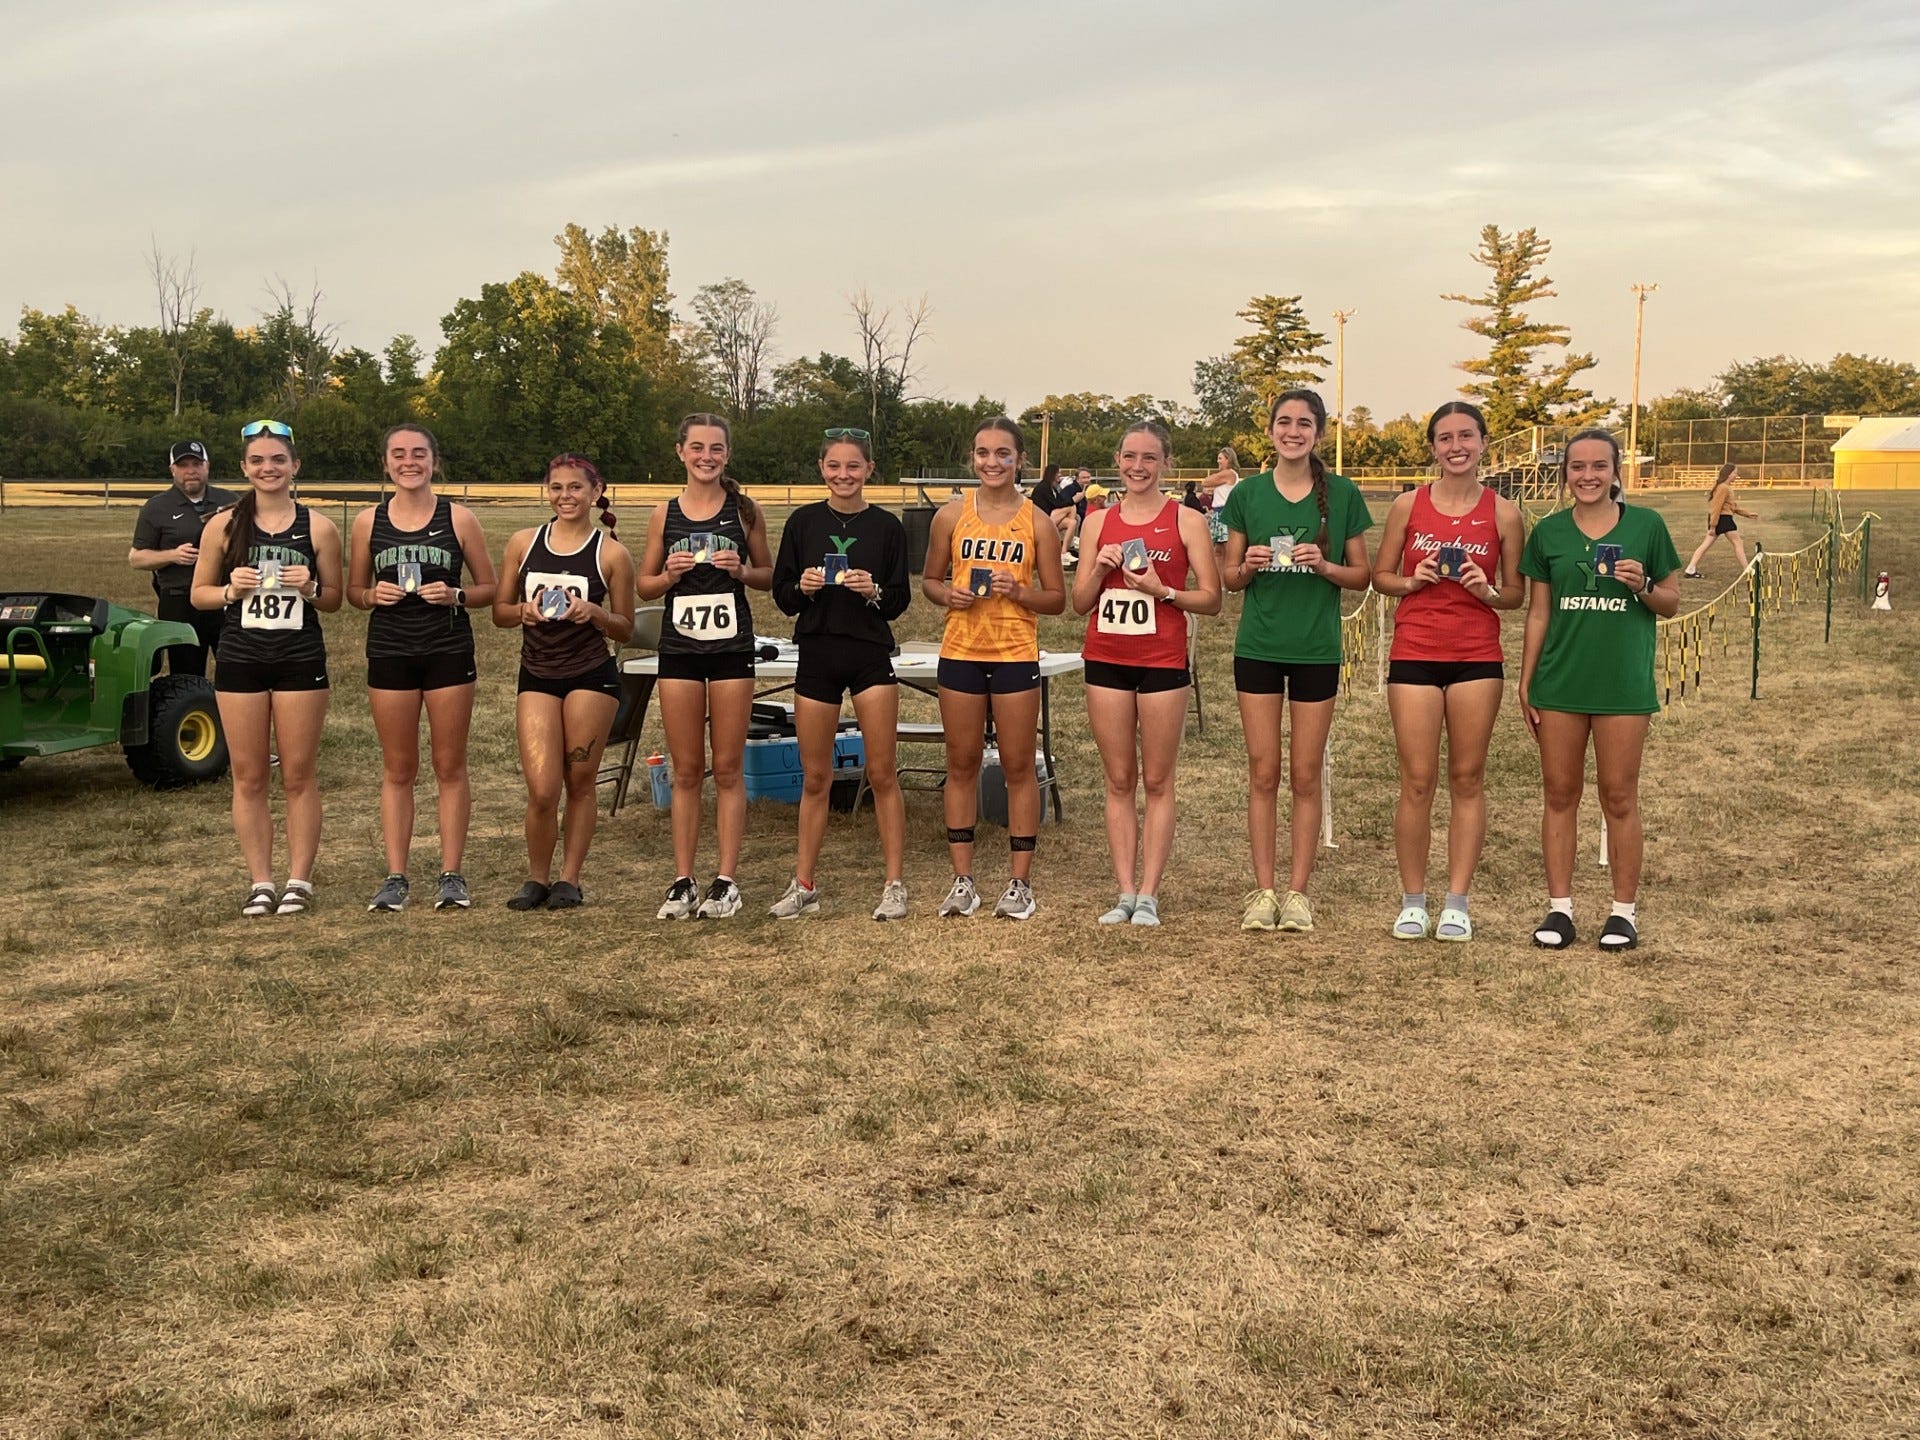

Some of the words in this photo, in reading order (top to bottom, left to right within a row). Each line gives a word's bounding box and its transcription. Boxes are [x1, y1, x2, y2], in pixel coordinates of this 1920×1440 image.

[828, 535, 858, 554] Y
[961, 537, 1024, 564] DELTA
[248, 594, 297, 619] 487
[680, 604, 731, 631] 476
[1102, 599, 1149, 624] 470
